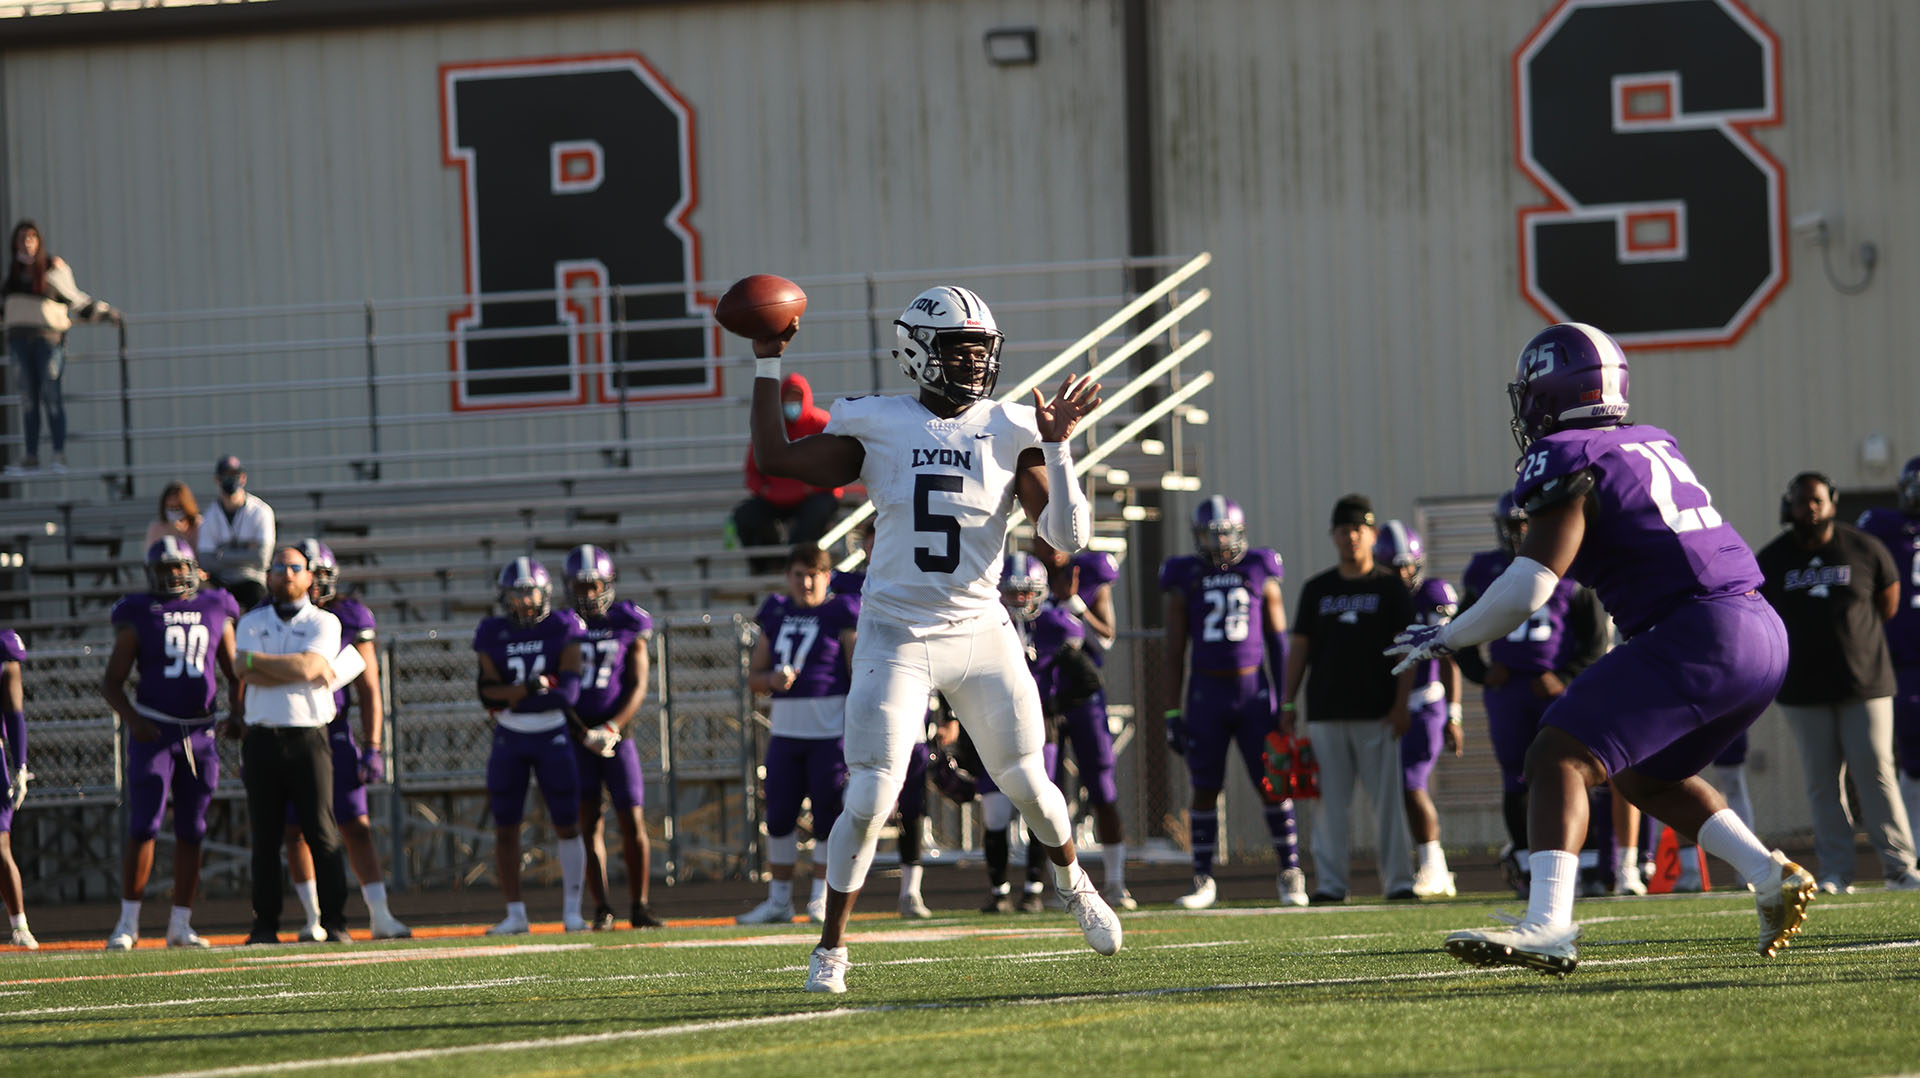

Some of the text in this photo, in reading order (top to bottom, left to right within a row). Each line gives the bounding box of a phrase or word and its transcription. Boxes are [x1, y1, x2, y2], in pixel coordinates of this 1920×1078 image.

[1511, 0, 1789, 352] S
[439, 51, 723, 411] R
[1524, 342, 1555, 382] 25
[911, 449, 971, 470] LYON
[1523, 450, 1549, 482] 25
[913, 473, 964, 574] 5
[164, 625, 209, 678] 90
[774, 623, 819, 673] 57
[1664, 847, 1678, 880] 2
